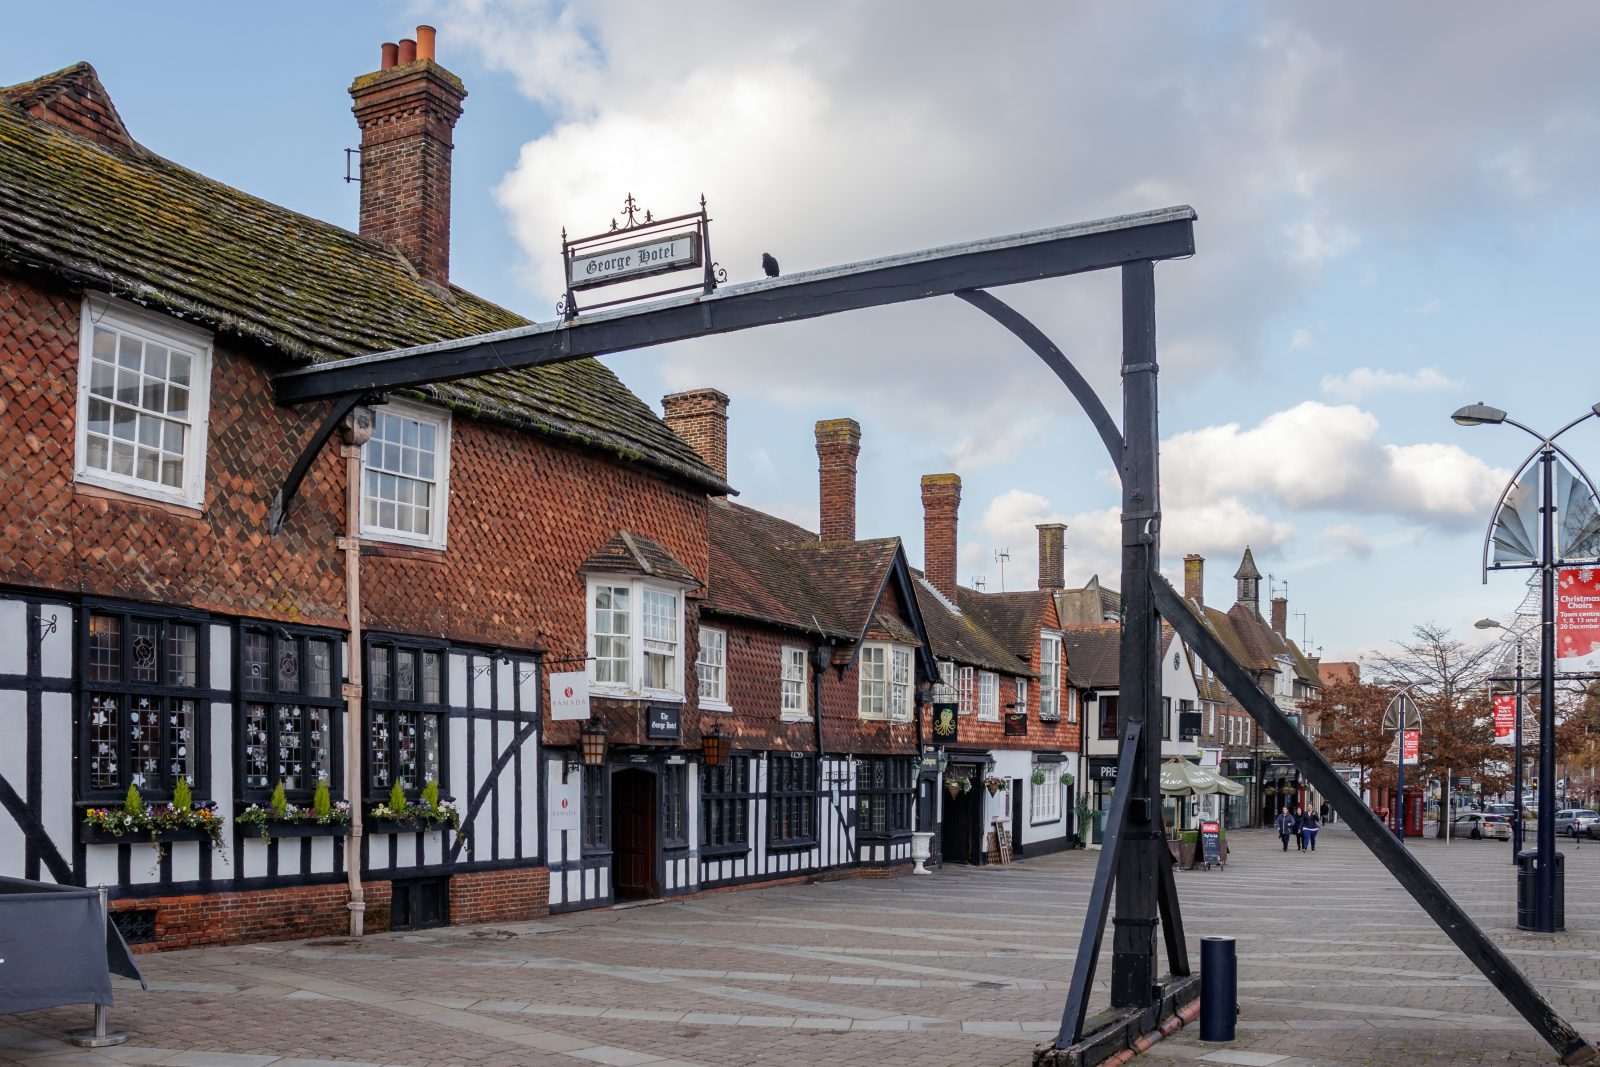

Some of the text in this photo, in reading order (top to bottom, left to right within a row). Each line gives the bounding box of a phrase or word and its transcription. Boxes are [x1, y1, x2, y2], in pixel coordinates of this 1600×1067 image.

[586, 242, 675, 275] George Hotel
[1560, 595, 1600, 603] Christmas
[660, 712, 669, 720] The
[651, 721, 677, 730] George Hotel
